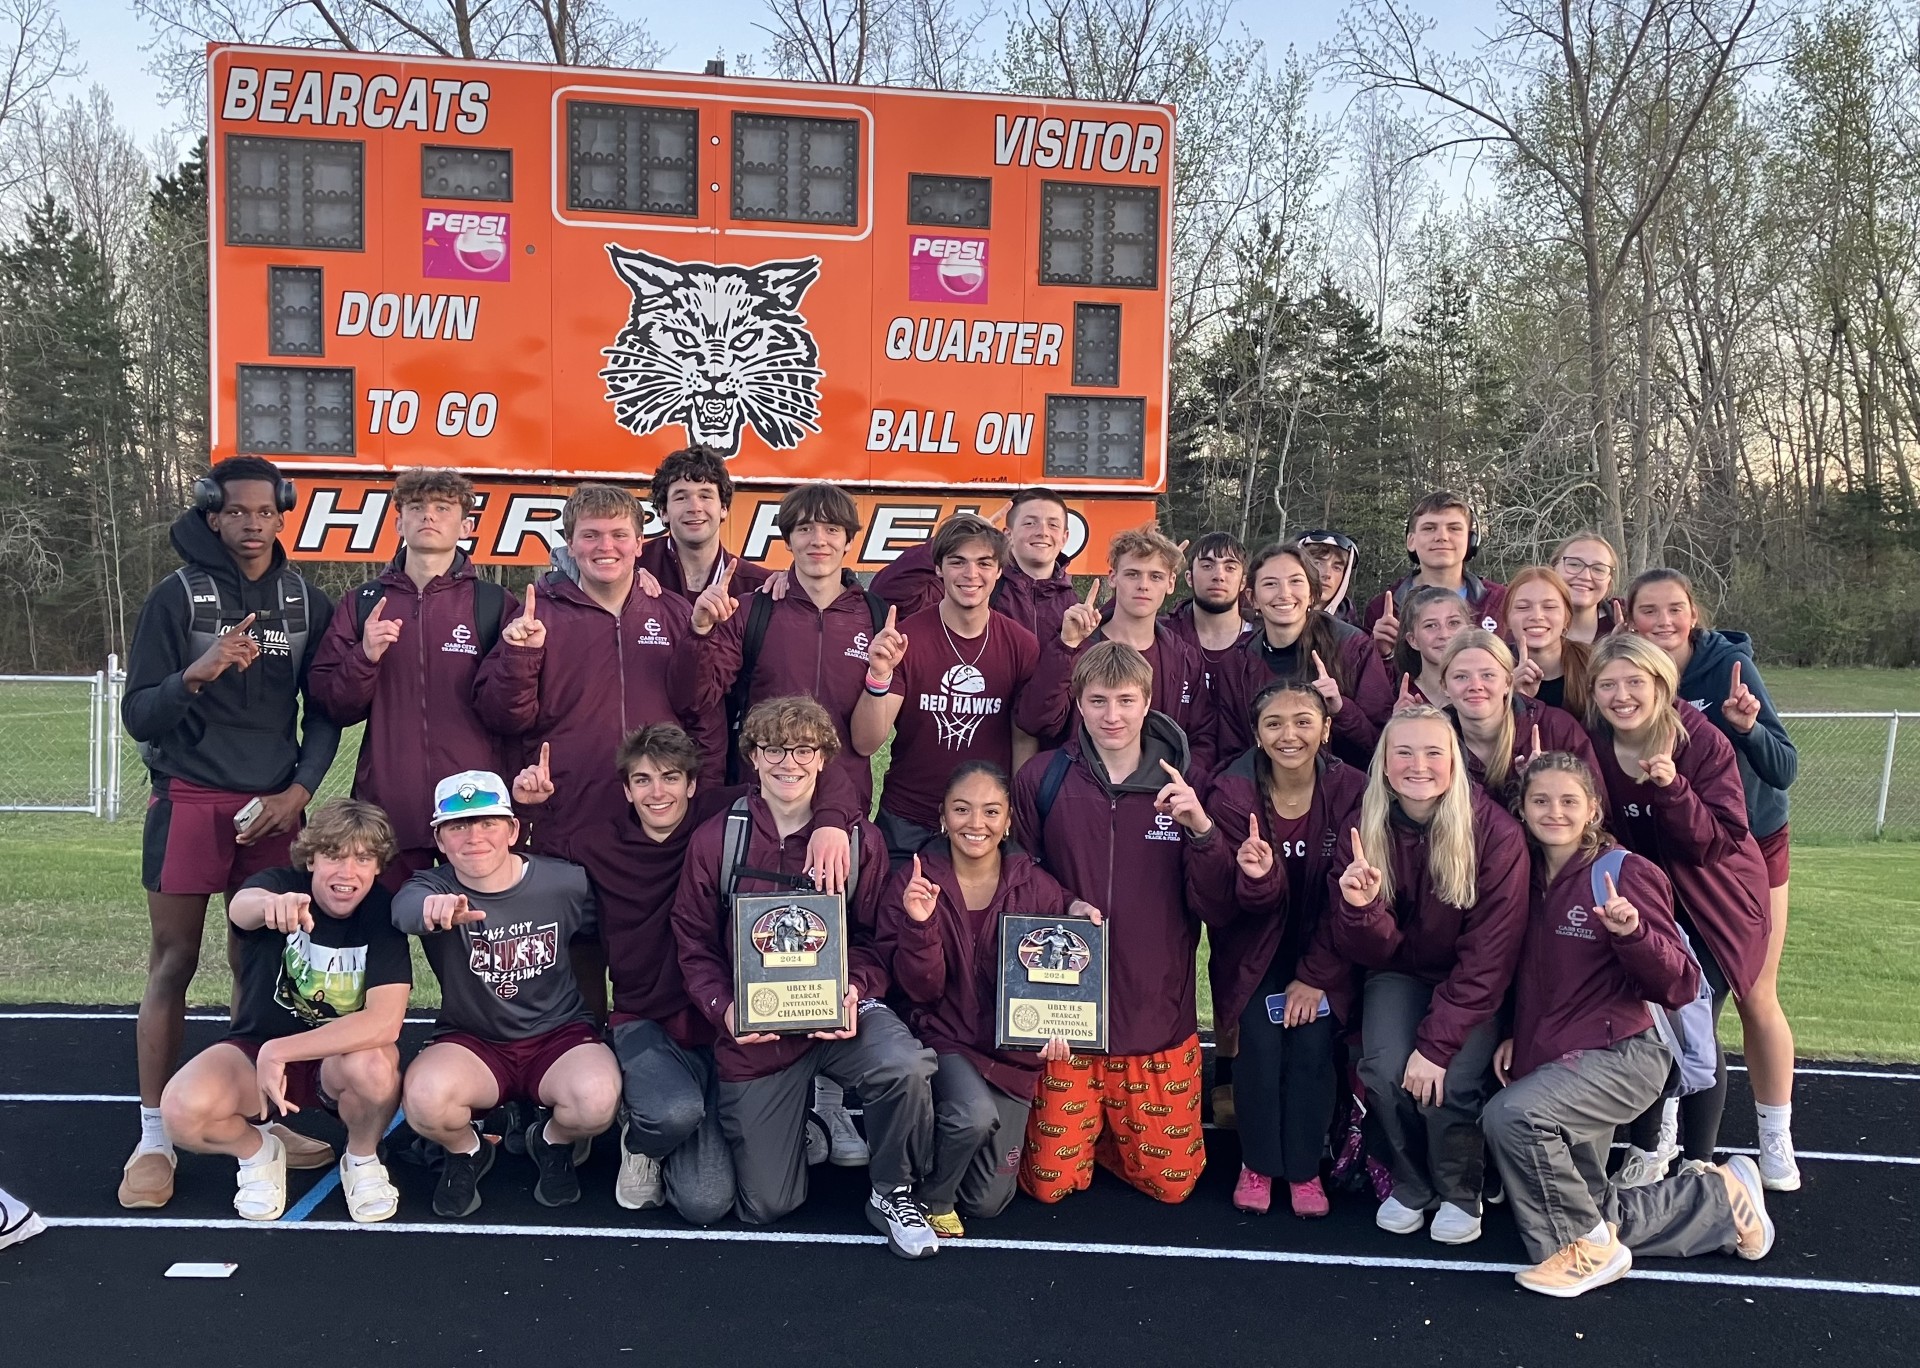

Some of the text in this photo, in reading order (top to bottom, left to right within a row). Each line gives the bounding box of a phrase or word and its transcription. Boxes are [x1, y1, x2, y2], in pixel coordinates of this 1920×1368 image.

[221, 67, 490, 134] BEARCATS
[993, 114, 1164, 174] VISITOR
[426, 212, 506, 236] PEPSI
[912, 237, 985, 261] PEPSI
[336, 290, 480, 341] DOWN
[885, 316, 1064, 366] QUARTER
[367, 389, 498, 438] TO GO
[865, 408, 1035, 456] BALL ON
[919, 693, 1002, 715] RED HAWKS
[482, 921, 533, 941] CASS CITY
[780, 955, 802, 963] 2024
[481, 965, 543, 983] RESTLING
[786, 984, 807, 992] UBLY
[777, 1008, 835, 1018] CHAMPIONS
[782, 1000, 829, 1008] INVITATIONAL
[1047, 1003, 1068, 1011] UBLY
[1037, 1027, 1093, 1037] CHAMPIONS
[1043, 1019, 1088, 1027] INVITATIONAL
